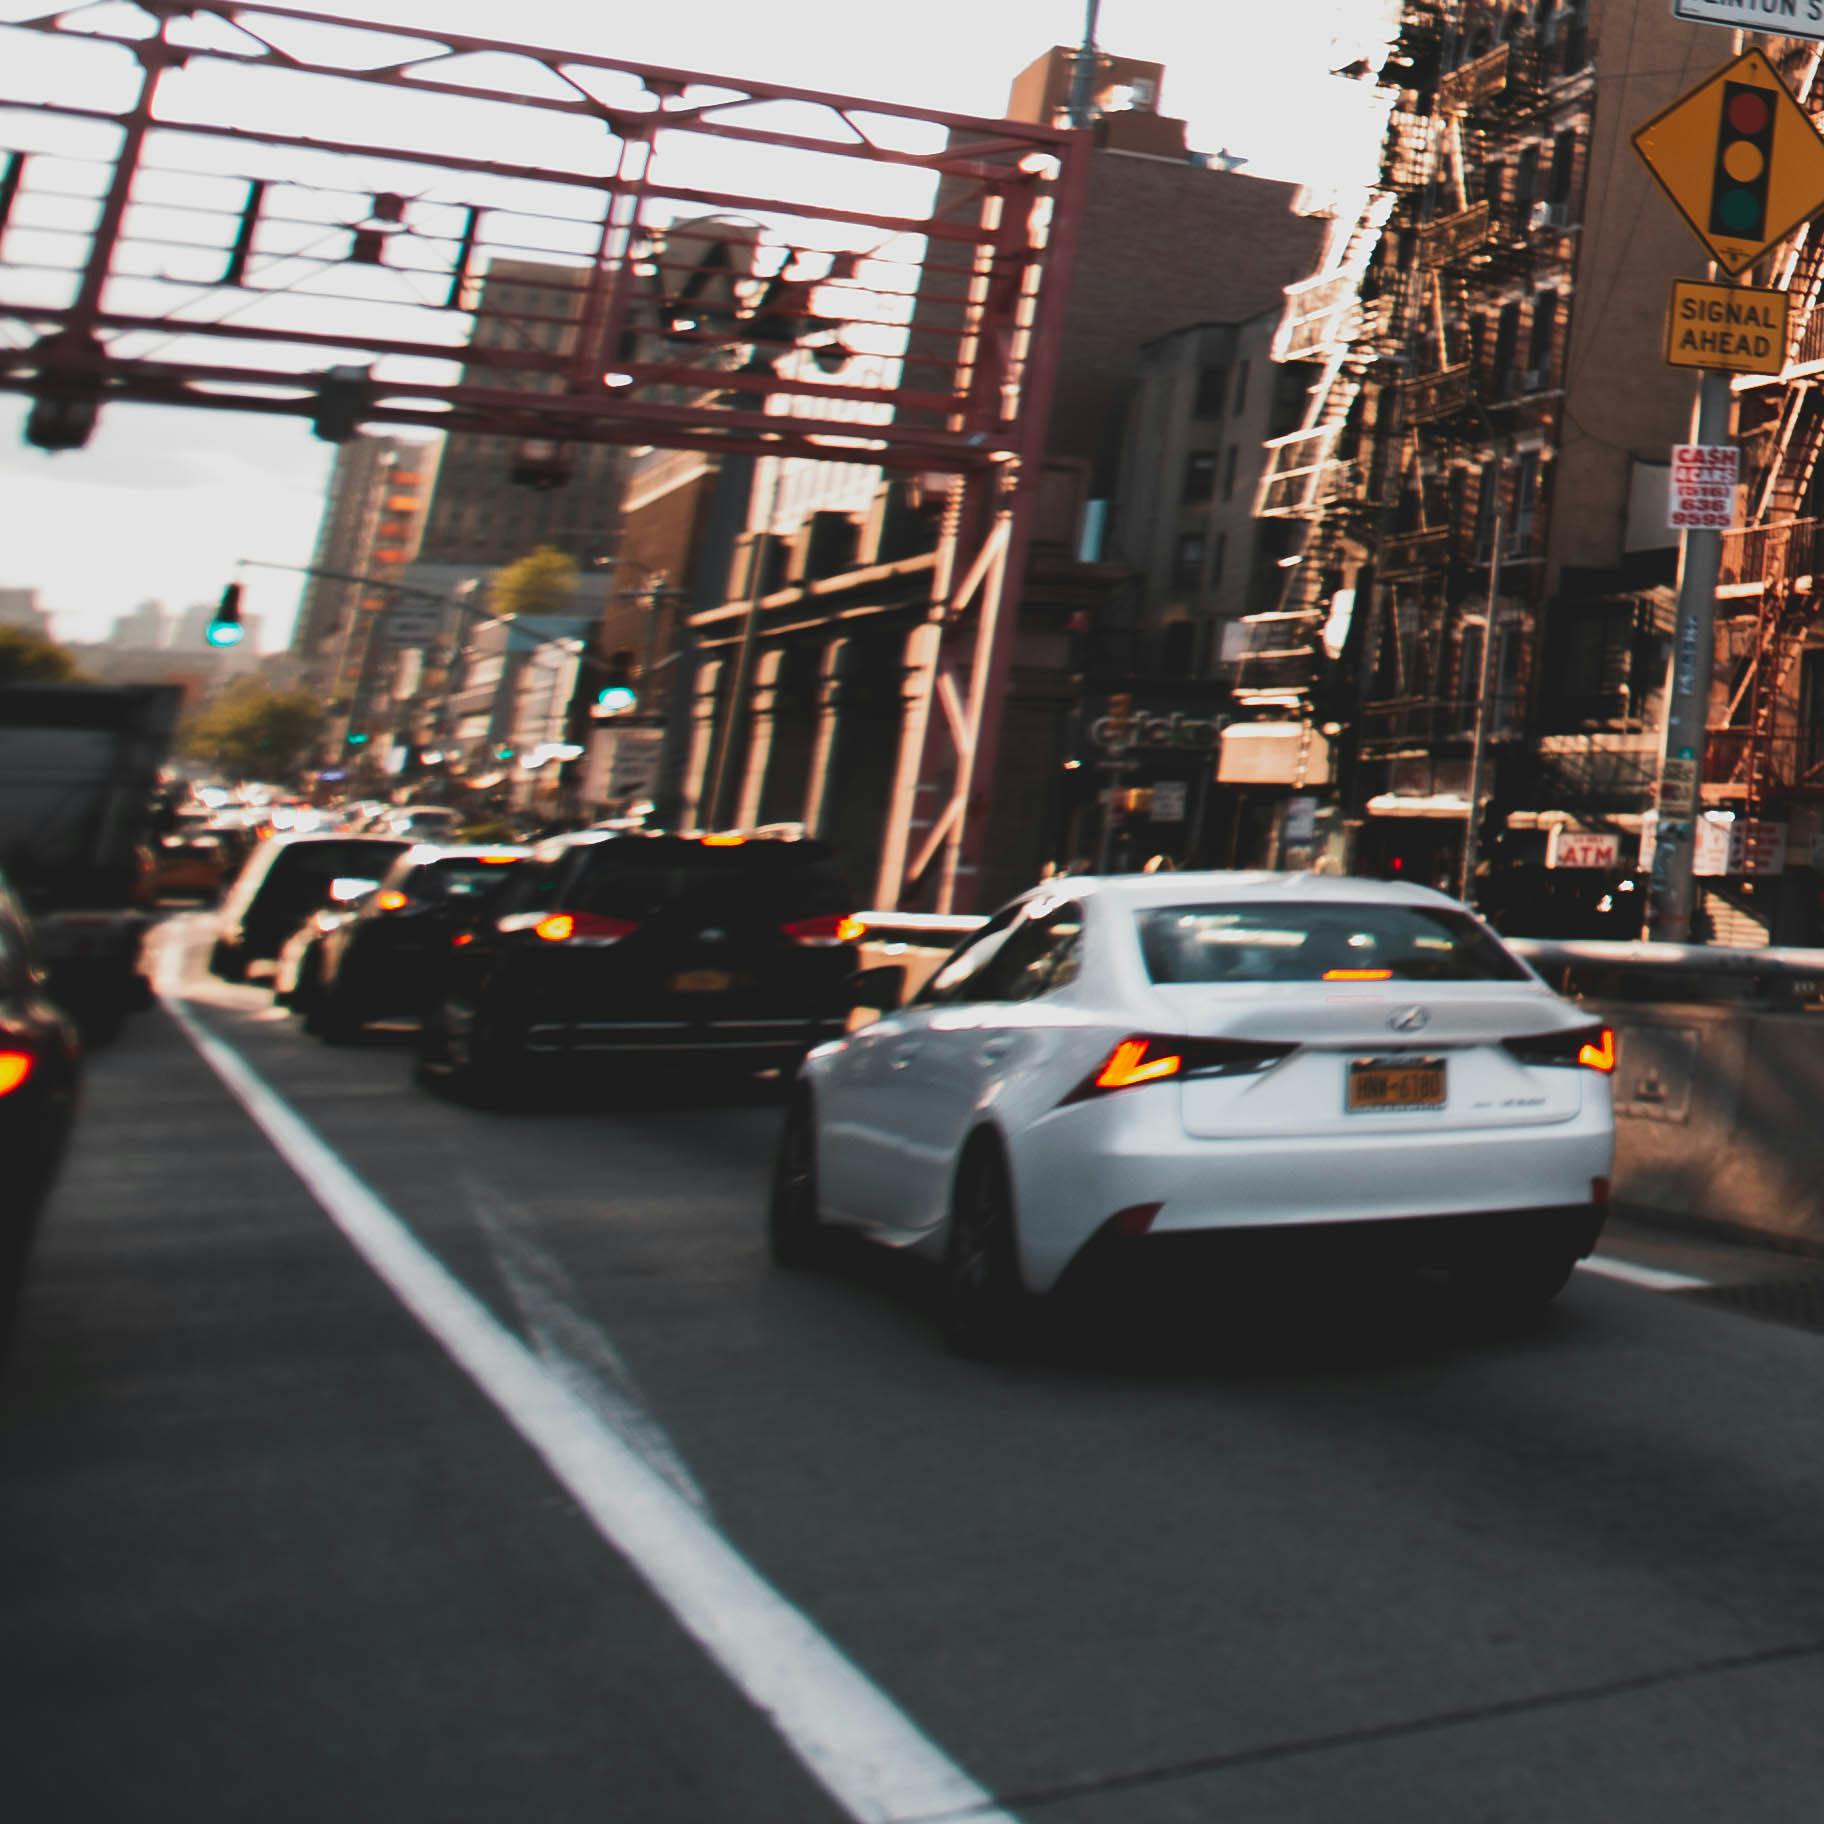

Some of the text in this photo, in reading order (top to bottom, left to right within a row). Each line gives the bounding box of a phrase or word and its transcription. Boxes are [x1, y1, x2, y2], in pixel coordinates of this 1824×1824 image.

[1680, 297, 1777, 329] SIGNAL
[1679, 328, 1771, 358] AHEAD
[1562, 847, 1613, 865] ATM
